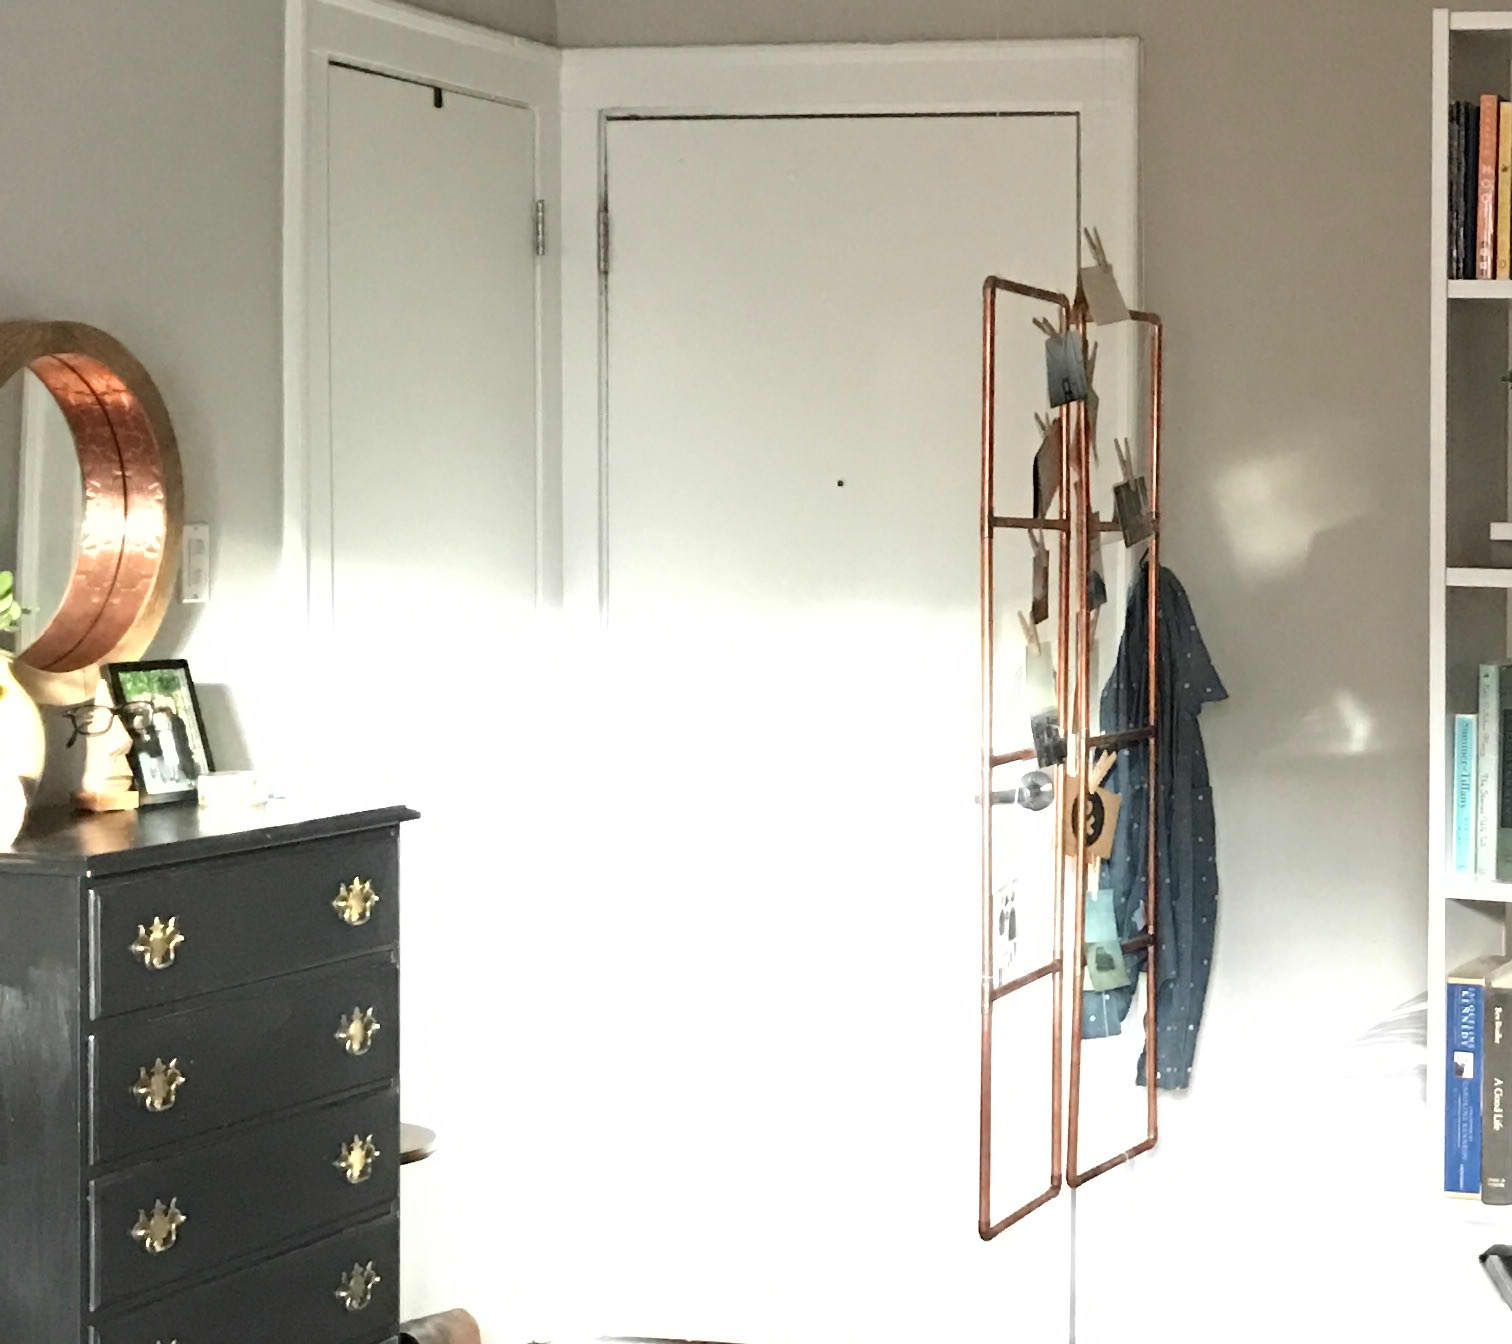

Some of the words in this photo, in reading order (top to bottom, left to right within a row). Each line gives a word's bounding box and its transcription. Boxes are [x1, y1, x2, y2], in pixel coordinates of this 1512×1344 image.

[1458, 772, 1473, 809] Tiffany
[1460, 989, 1470, 1048] KENNEDY
[1467, 986, 1477, 1049] JACQUELINE
[1493, 1076, 1505, 1085] A
[1492, 1086, 1503, 1112] Good
[1492, 1112, 1503, 1132] Life
